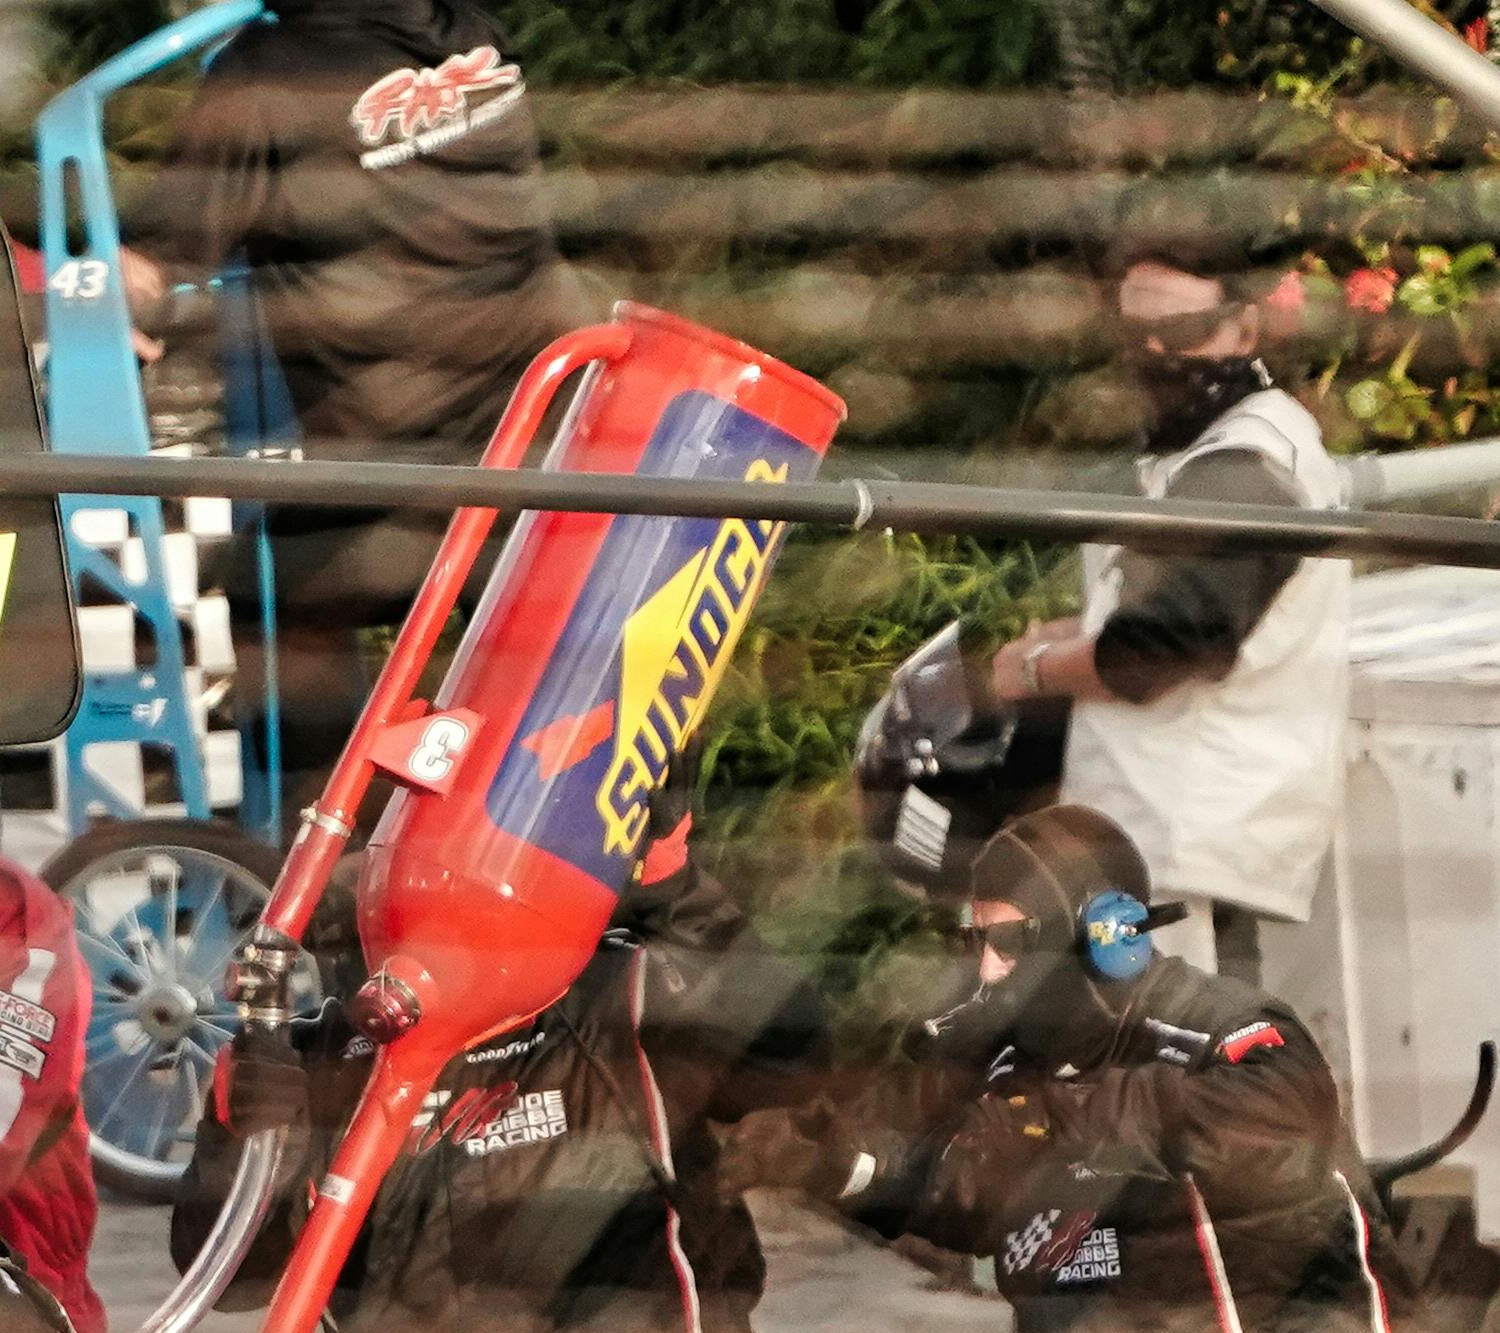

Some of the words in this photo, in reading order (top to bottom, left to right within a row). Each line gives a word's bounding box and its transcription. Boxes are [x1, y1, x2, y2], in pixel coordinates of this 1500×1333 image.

[47, 259, 109, 299] 43
[409, 717, 468, 782] 3
[507, 1090, 563, 1115] JOE
[485, 1105, 566, 1136] GIBBS
[466, 1122, 568, 1156] RACING
[1057, 1261, 1122, 1282] RACING
